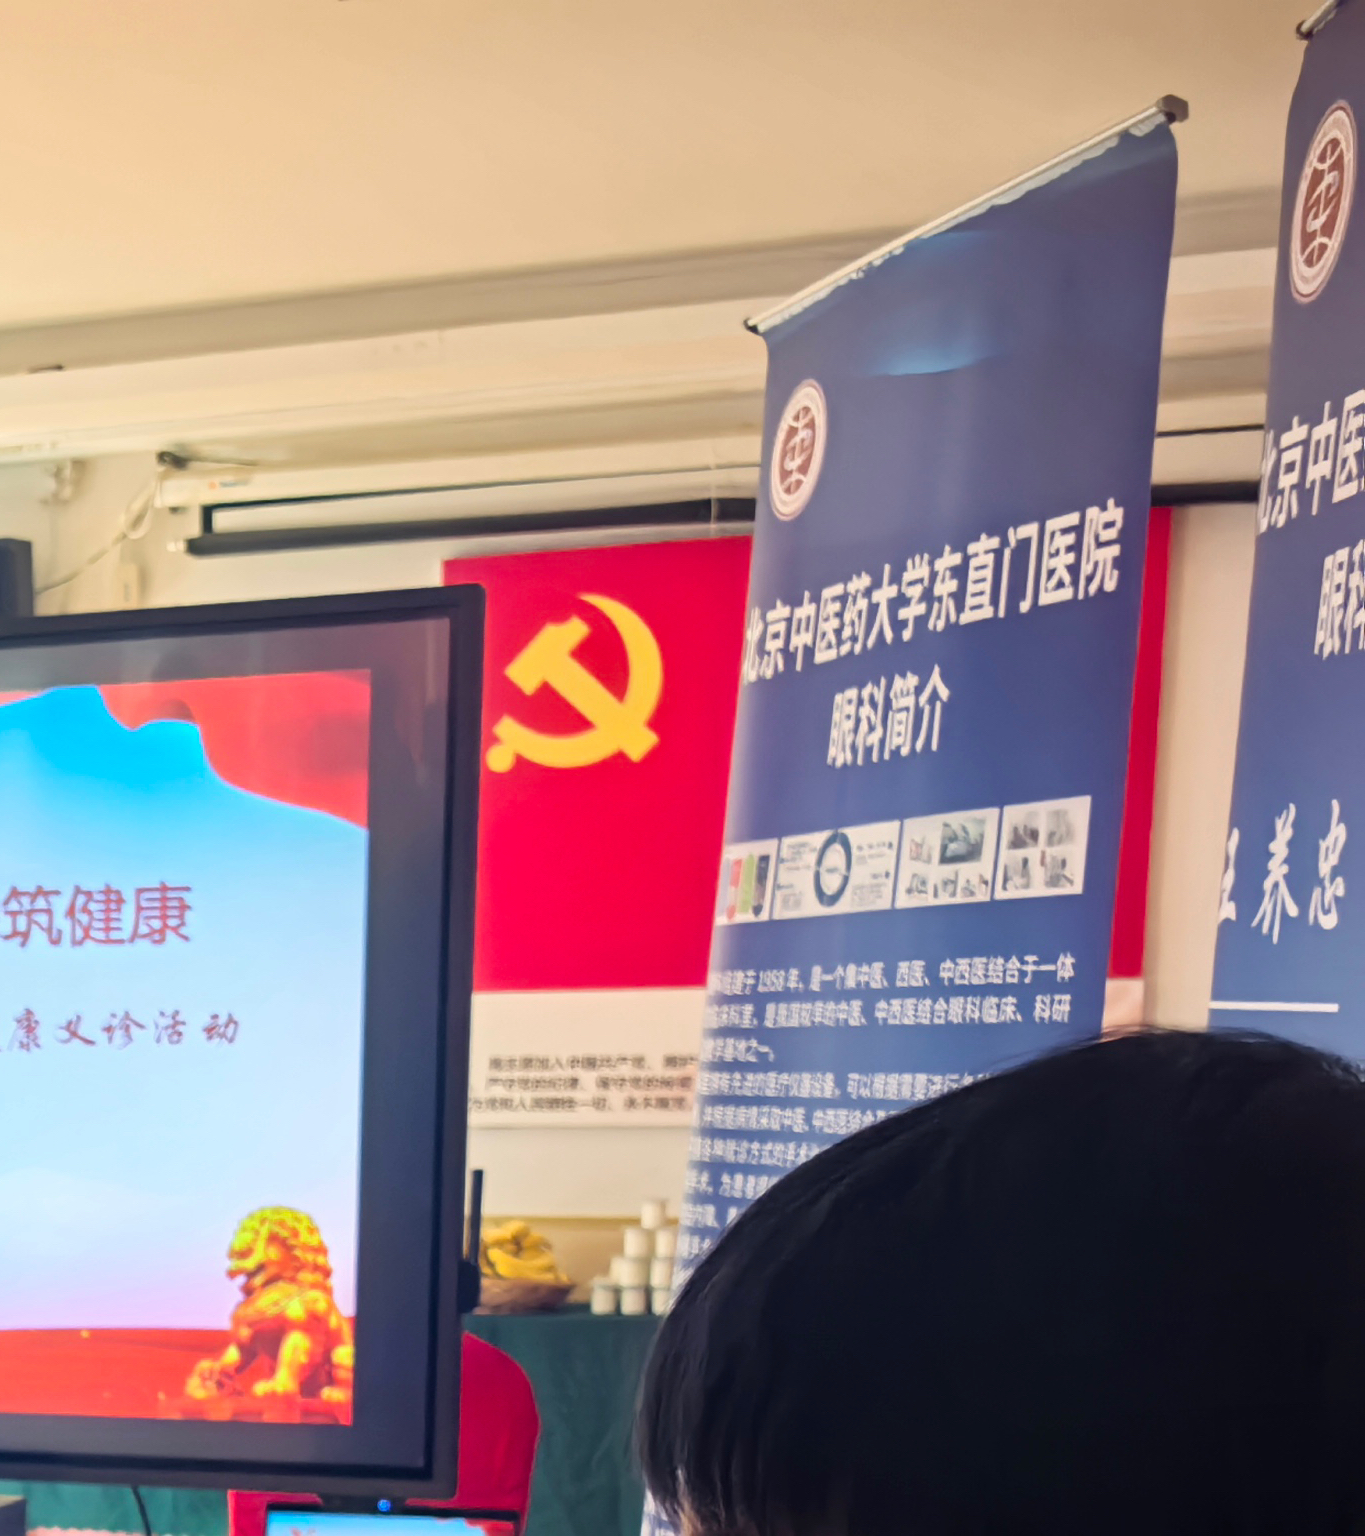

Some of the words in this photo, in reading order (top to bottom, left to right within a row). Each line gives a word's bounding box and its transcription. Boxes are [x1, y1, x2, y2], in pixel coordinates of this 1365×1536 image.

[1258, 389, 1365, 536] 北京中医
[743, 498, 1125, 685] 北京中医药大学东直门医院
[827, 664, 951, 768] 眼科简介
